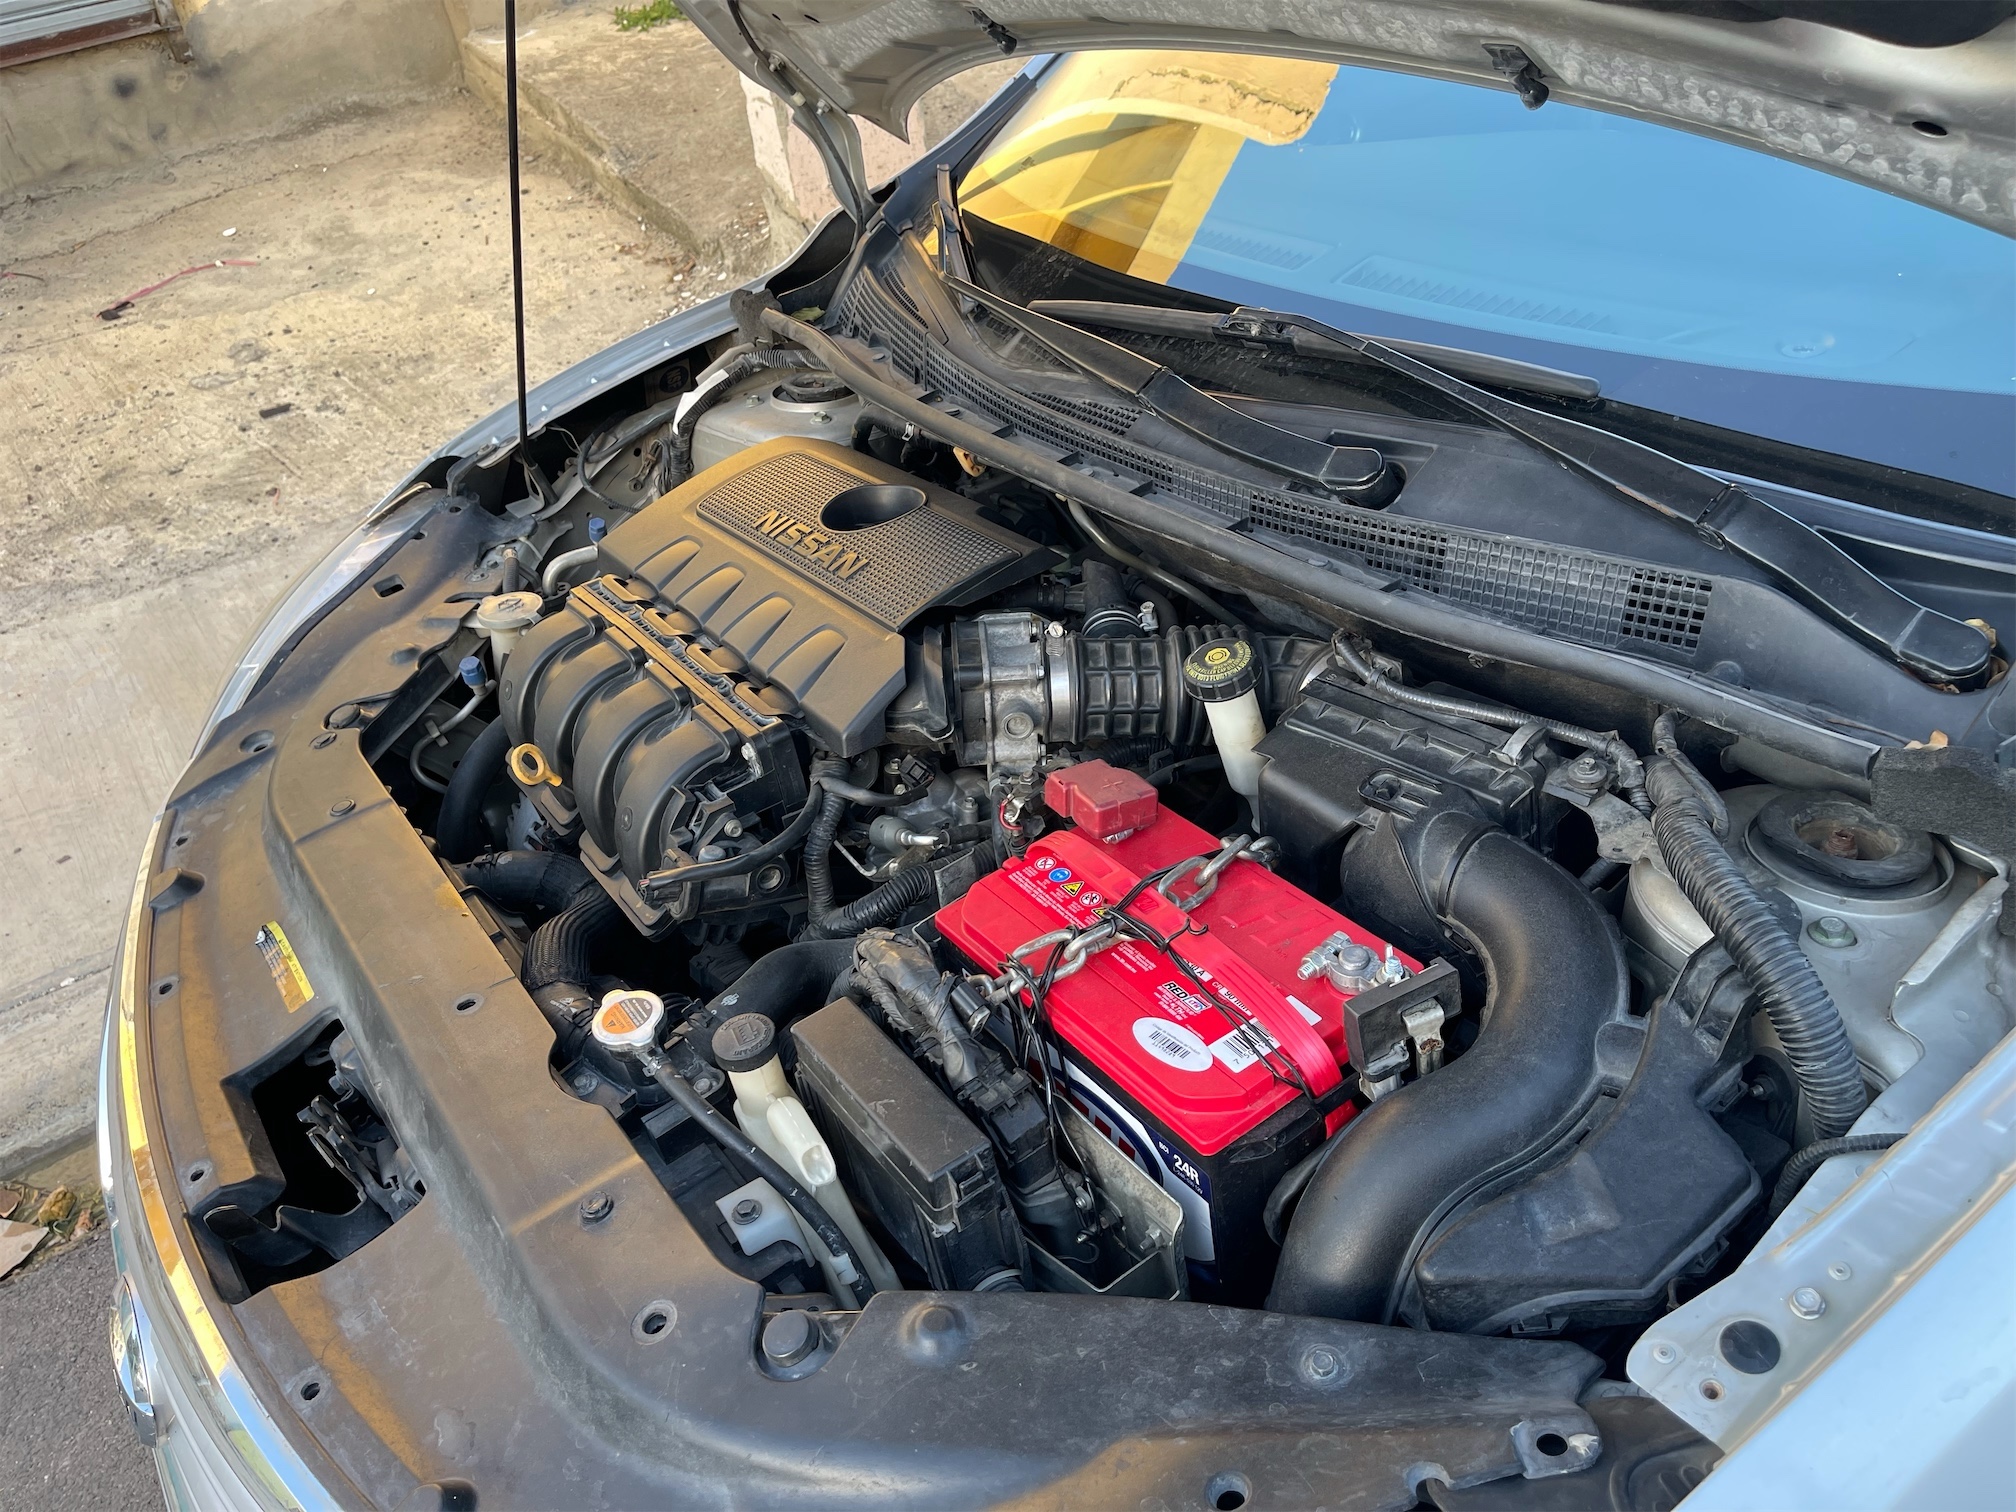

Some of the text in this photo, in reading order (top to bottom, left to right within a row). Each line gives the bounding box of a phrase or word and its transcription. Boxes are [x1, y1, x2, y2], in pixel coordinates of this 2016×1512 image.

[752, 509, 871, 580] NISSAN
[1164, 981, 1189, 999] RED
[1173, 1153, 1200, 1186] 24R
